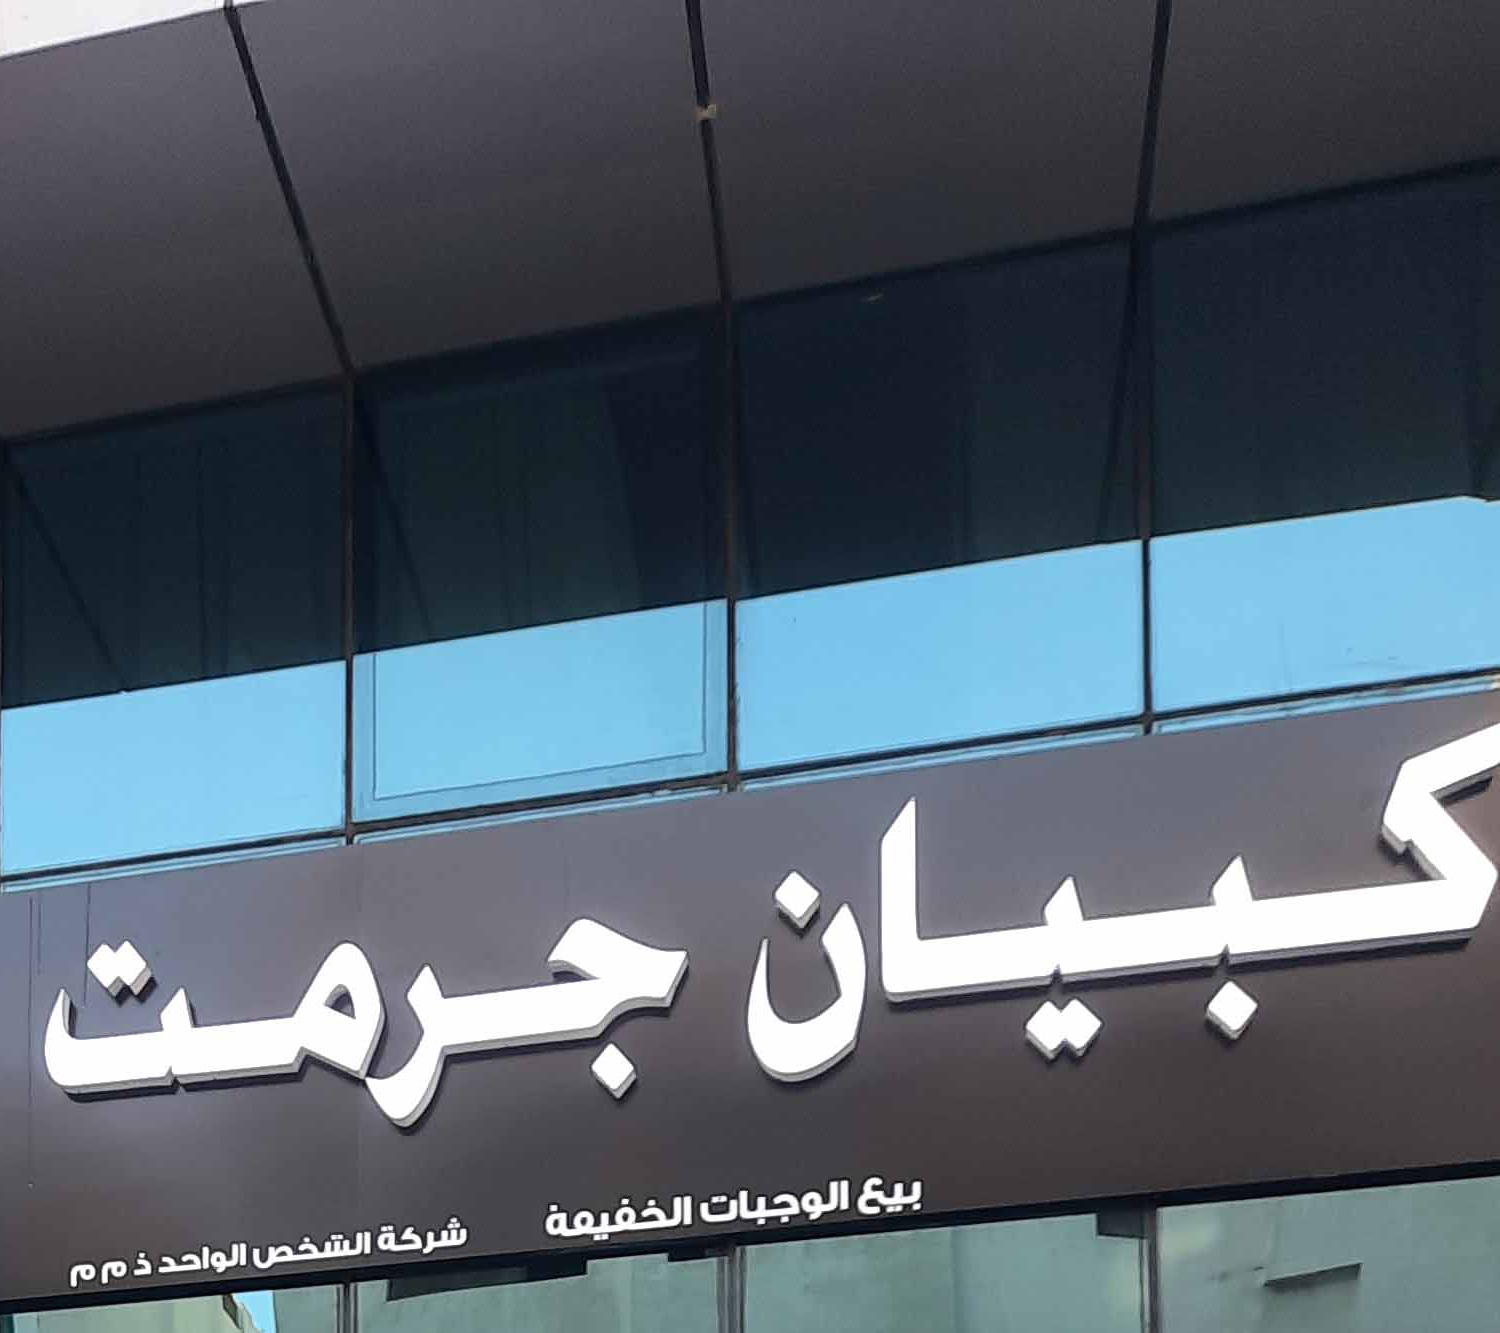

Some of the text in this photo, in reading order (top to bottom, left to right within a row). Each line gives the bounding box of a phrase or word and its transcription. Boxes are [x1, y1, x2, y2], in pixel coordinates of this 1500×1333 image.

[44, 722, 1500, 1124] كبيان جرمت
[699, 1179, 849, 1226] الوجبات
[857, 1179, 922, 1216] بيع
[70, 1217, 467, 1288] شركة الشخص الواحد ذ م م
